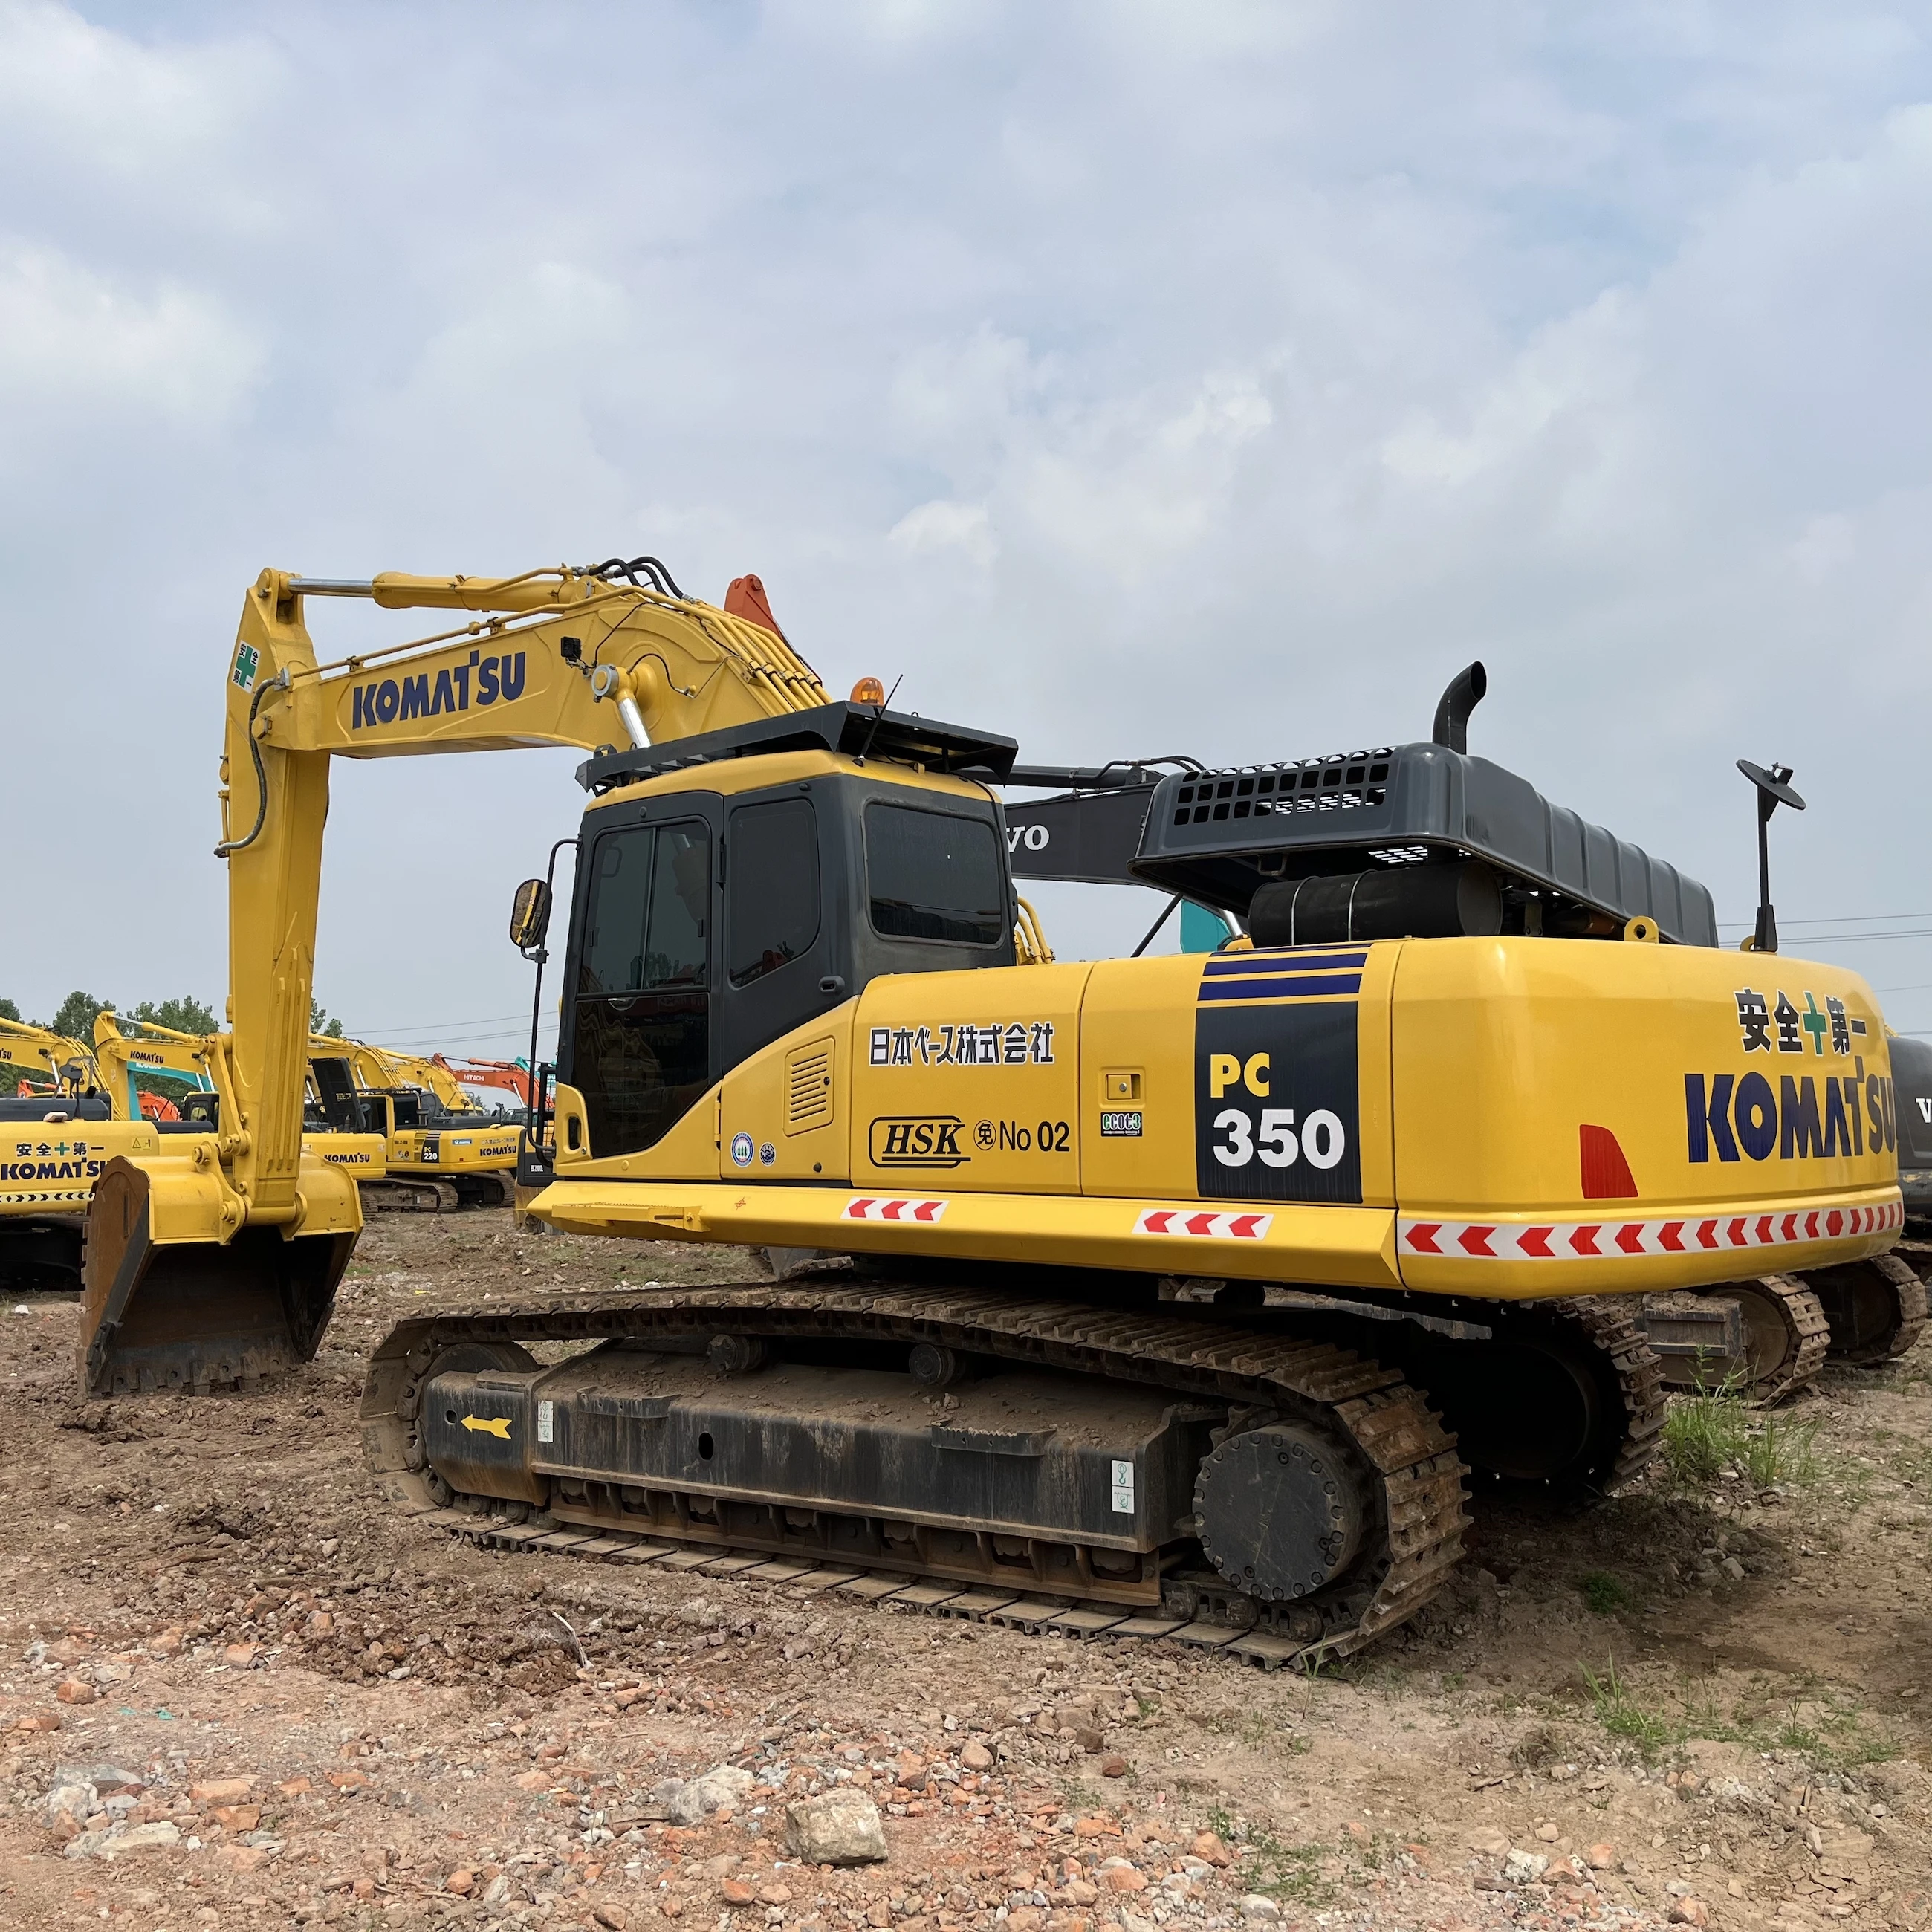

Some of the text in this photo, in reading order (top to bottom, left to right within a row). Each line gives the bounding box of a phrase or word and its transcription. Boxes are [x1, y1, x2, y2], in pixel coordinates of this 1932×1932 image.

[352, 649, 526, 730] KOMATSU
[130, 1050, 164, 1064] KOMATSU
[869, 1021, 1054, 1066] 日本ベース株式会社
[464, 1074, 485, 1082] HITACHI
[1210, 1051, 1271, 1098] PC
[1102, 1112, 1141, 1131] ecot3
[1684, 1055, 1896, 1164] KOMATSU
[479, 1144, 517, 1156] KOMATSU
[882, 1123, 965, 1155] HSK
[999, 1120, 1031, 1151] No
[1037, 1121, 1071, 1153] 02
[1212, 1108, 1346, 1170] 350
[424, 1153, 438, 1161] 220
